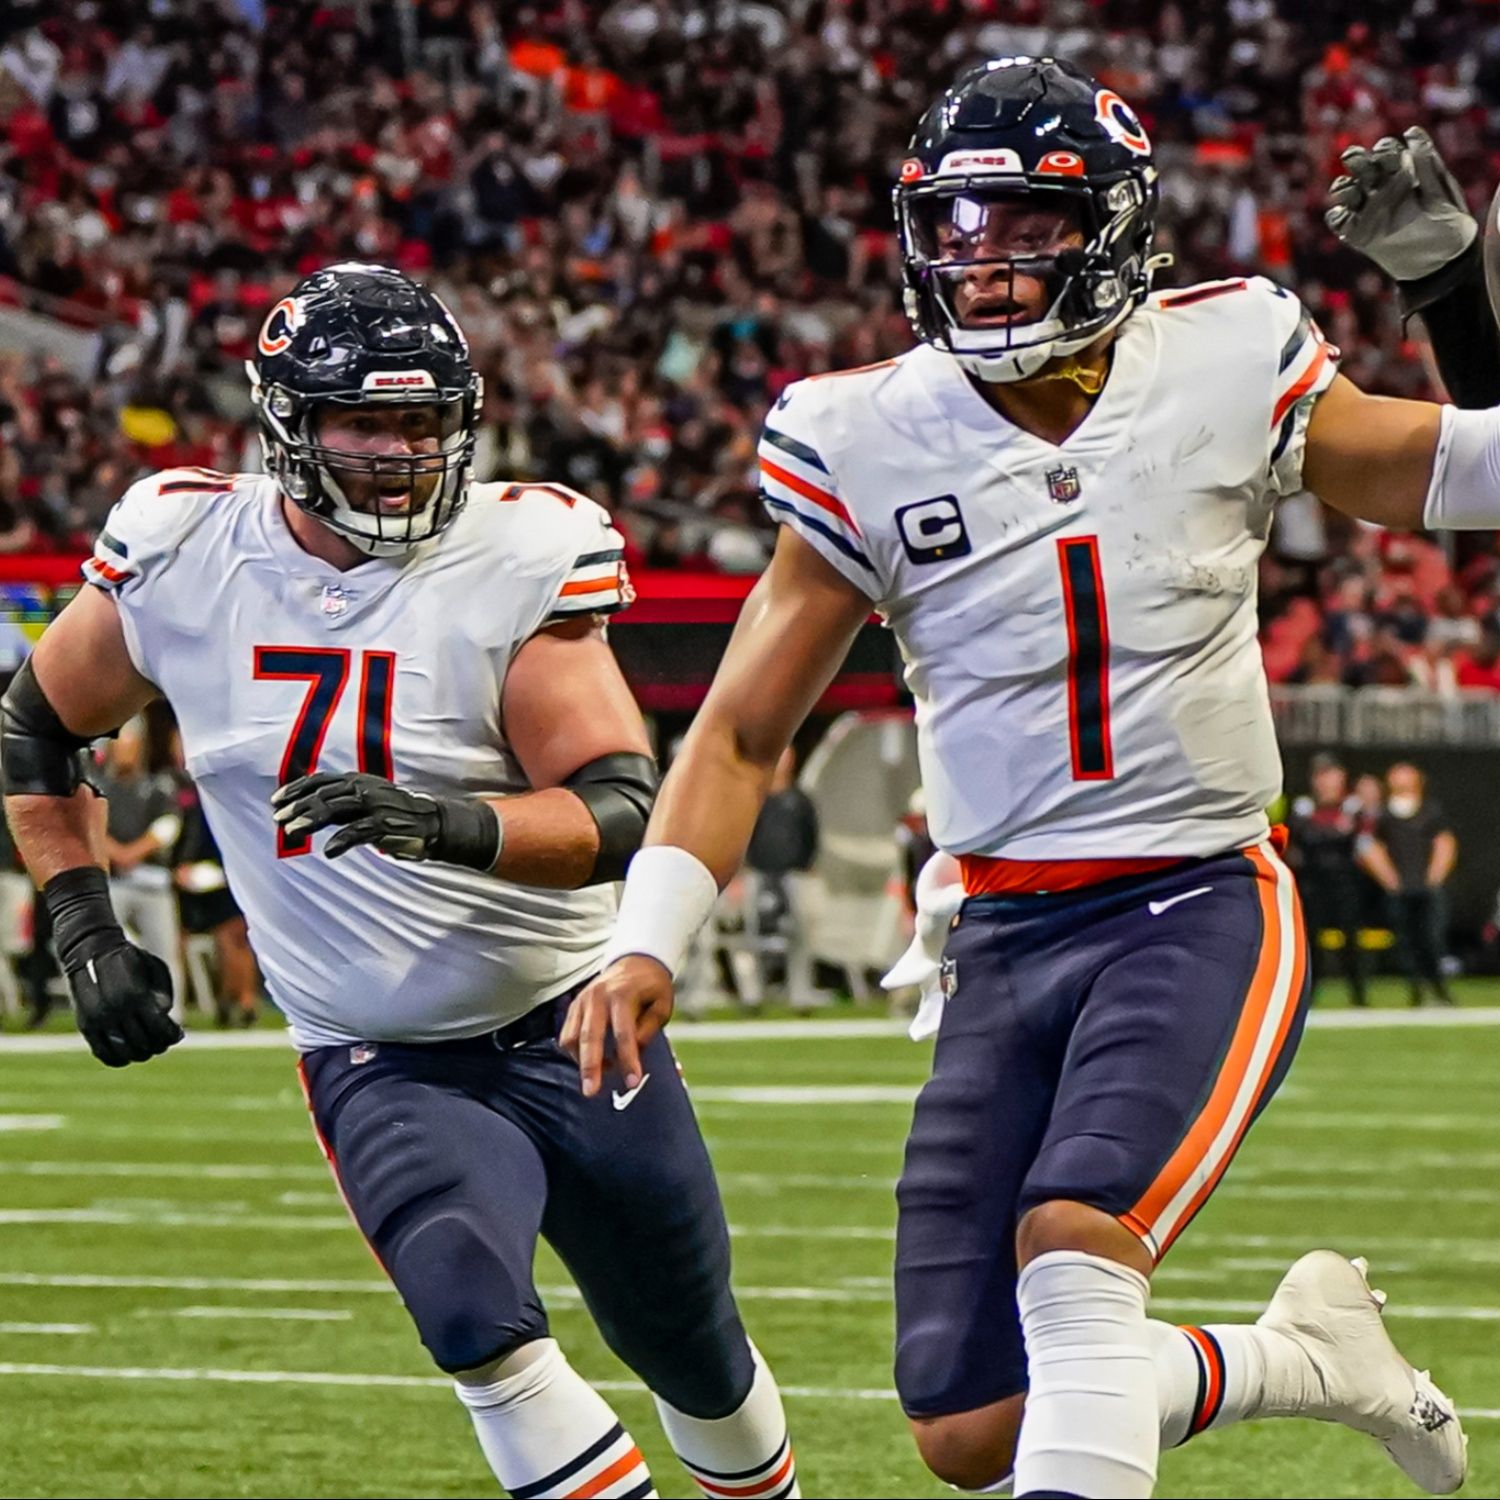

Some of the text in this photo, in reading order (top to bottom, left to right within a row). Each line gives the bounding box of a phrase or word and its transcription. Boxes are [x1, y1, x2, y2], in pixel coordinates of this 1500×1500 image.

[258, 297, 305, 357] C
[902, 500, 961, 550] C
[1057, 534, 1114, 782] 1
[252, 645, 397, 859] 71
